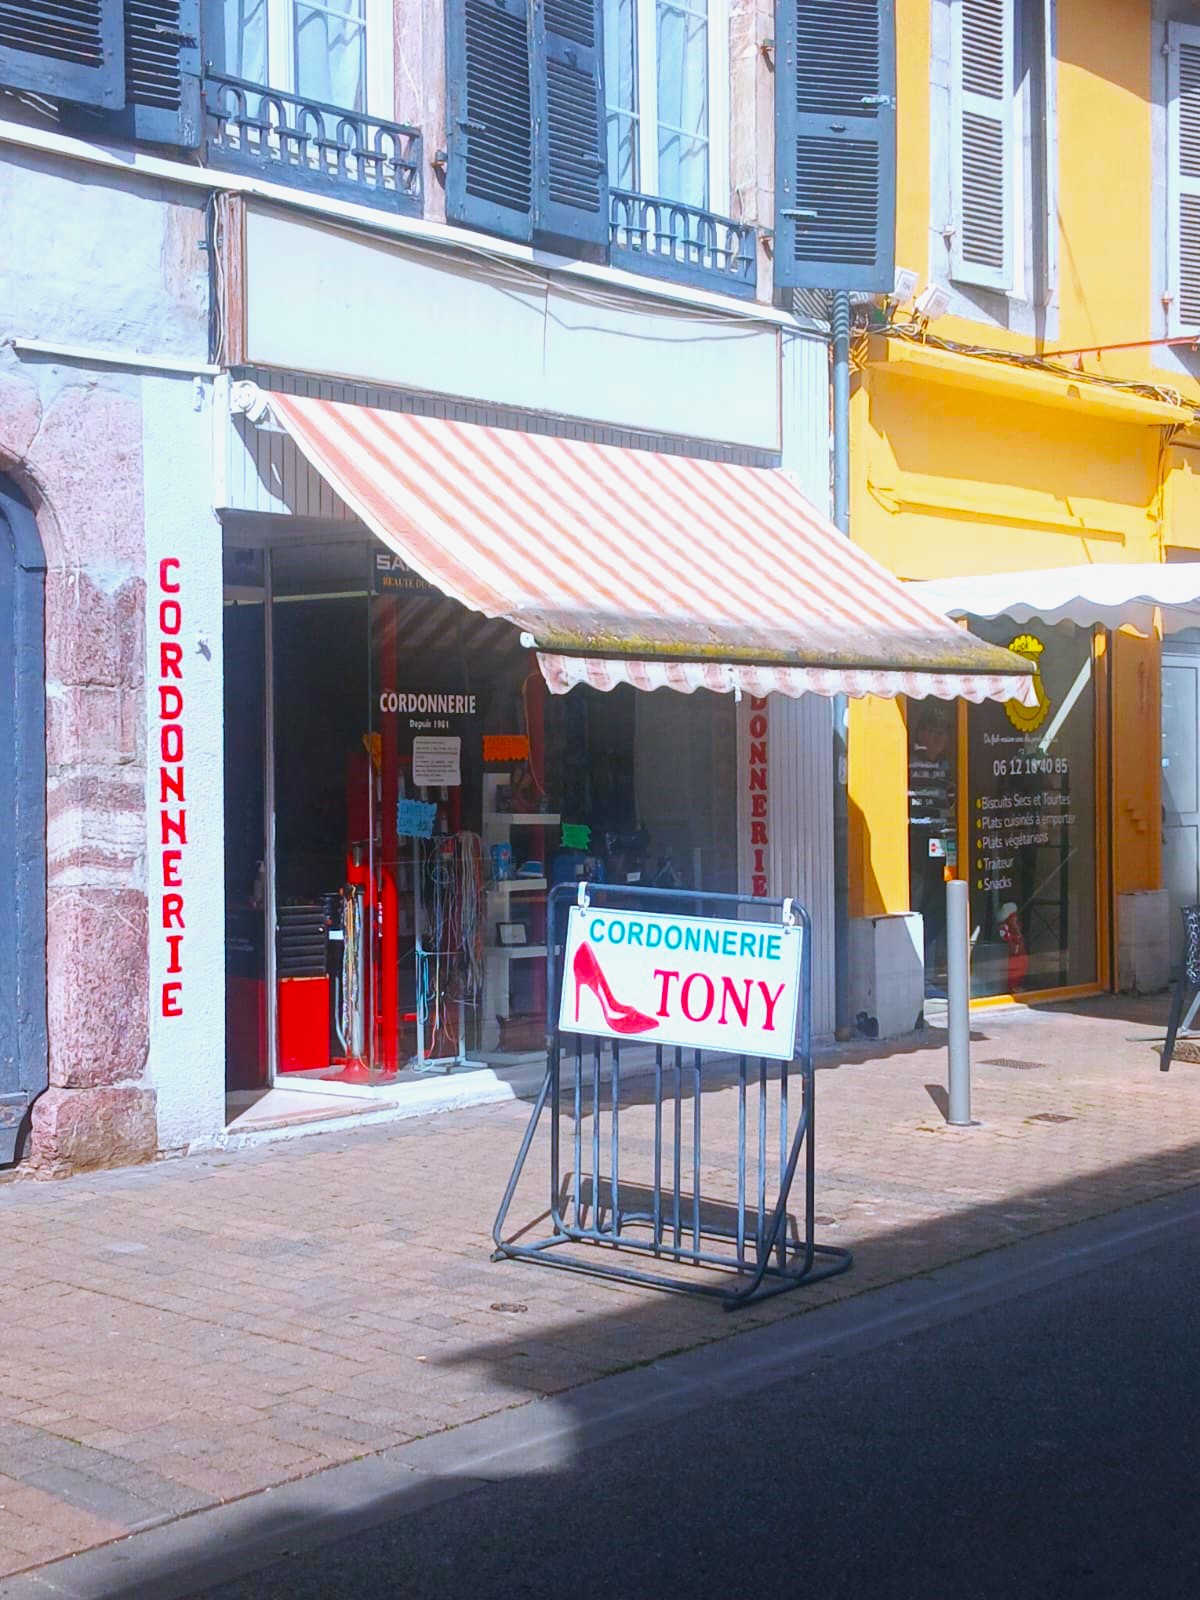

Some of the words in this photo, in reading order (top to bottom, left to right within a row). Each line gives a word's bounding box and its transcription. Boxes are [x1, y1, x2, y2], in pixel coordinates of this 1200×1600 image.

[379, 693, 477, 714] CORDONNERIE
[993, 759, 1007, 777] 06
[1009, 758, 1023, 775] 12
[1039, 757, 1054, 775] 40
[1054, 757, 1068, 775] 85
[158, 557, 188, 1018] CORDONNERIE
[982, 795, 1013, 810] Biscuits
[1013, 793, 1032, 807] Secs
[1032, 794, 1041, 806] et
[982, 816, 1003, 829] Plats
[982, 836, 1003, 849] Plats
[983, 857, 1014, 871] Traiteur
[984, 876, 1012, 891] Snacks
[590, 918, 782, 961] CORDONNERIE
[653, 968, 786, 1032] TONY
